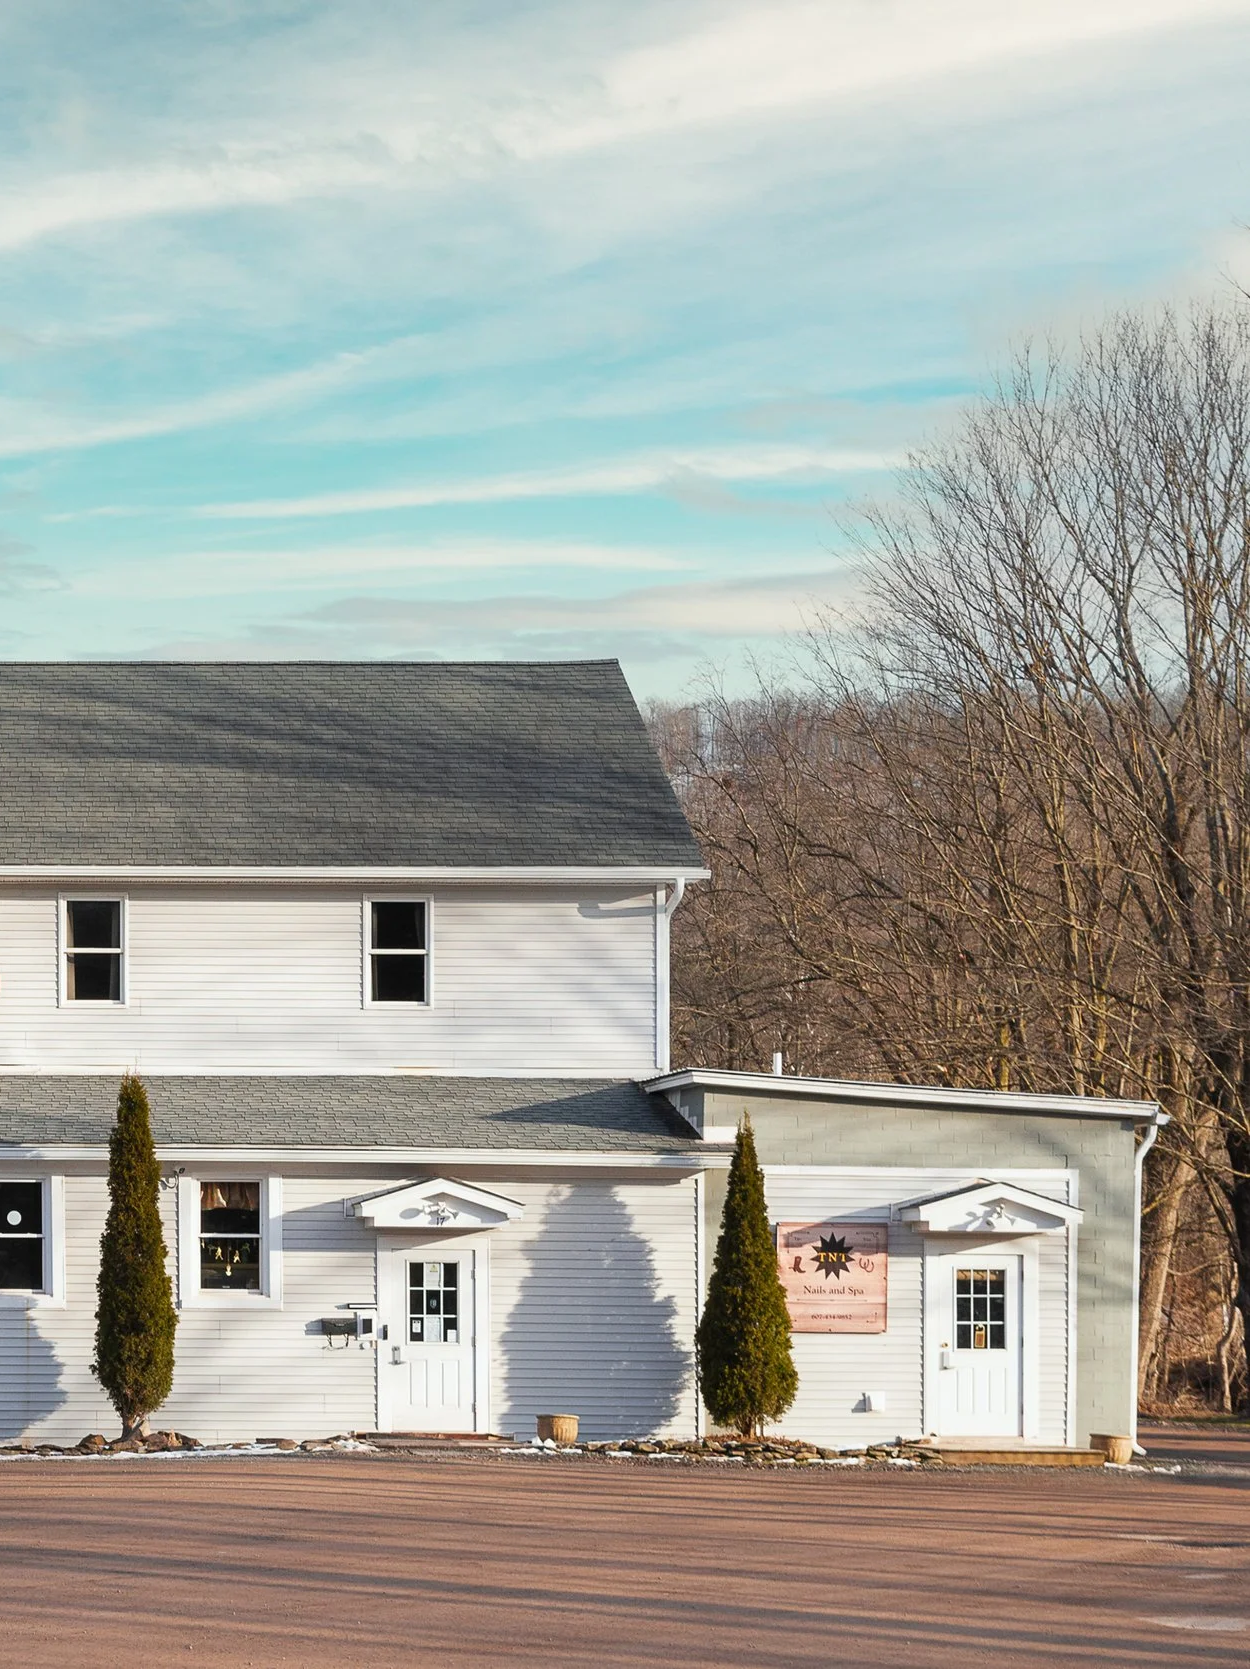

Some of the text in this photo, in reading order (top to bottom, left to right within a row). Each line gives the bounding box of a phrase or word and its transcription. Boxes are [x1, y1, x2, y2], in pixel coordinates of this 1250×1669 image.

[436, 1217, 446, 1225] 17
[817, 1252, 847, 1262] TNT
[803, 1285, 865, 1296] Nails and Spa
